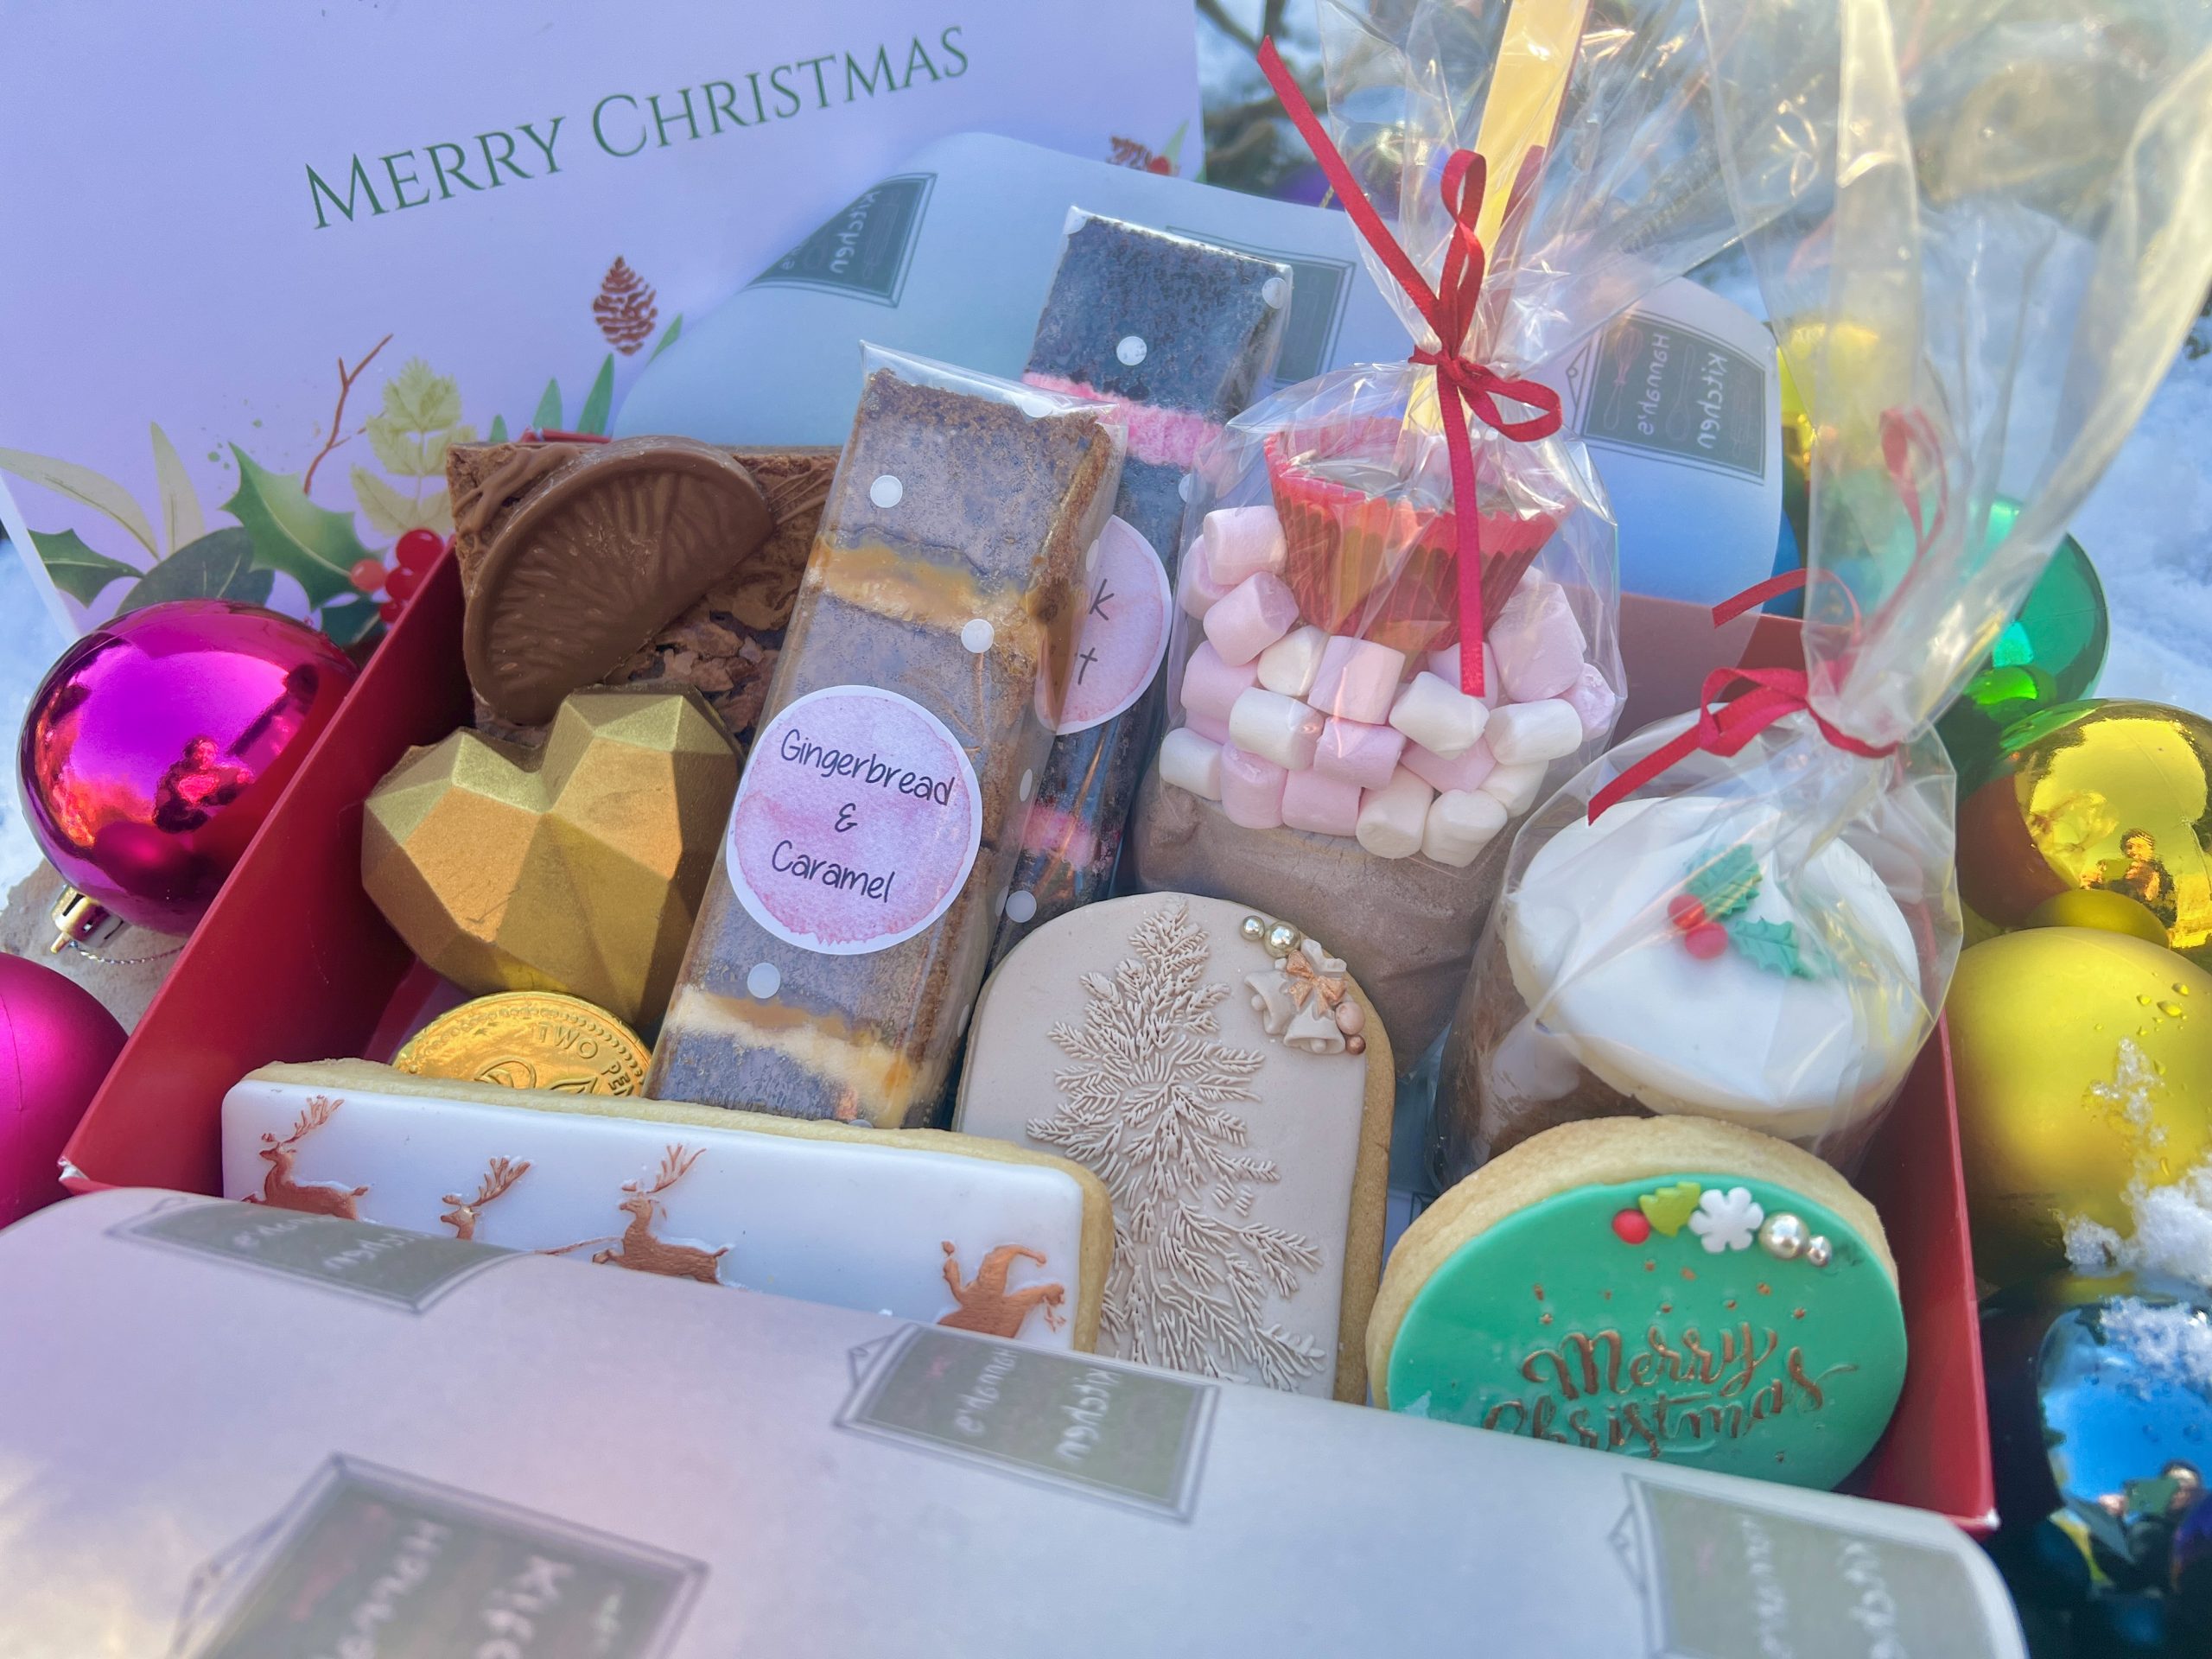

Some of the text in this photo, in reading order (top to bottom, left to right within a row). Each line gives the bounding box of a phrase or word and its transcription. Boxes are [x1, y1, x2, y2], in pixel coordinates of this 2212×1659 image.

[305, 24, 970, 231] MERRY CHRISTMAS
[780, 728, 957, 807] Gingerbread
[834, 802, 859, 834] &
[772, 840, 896, 904] Caramel
[533, 1021, 599, 1059] TWO
[1522, 1321, 1779, 1402] Merry
